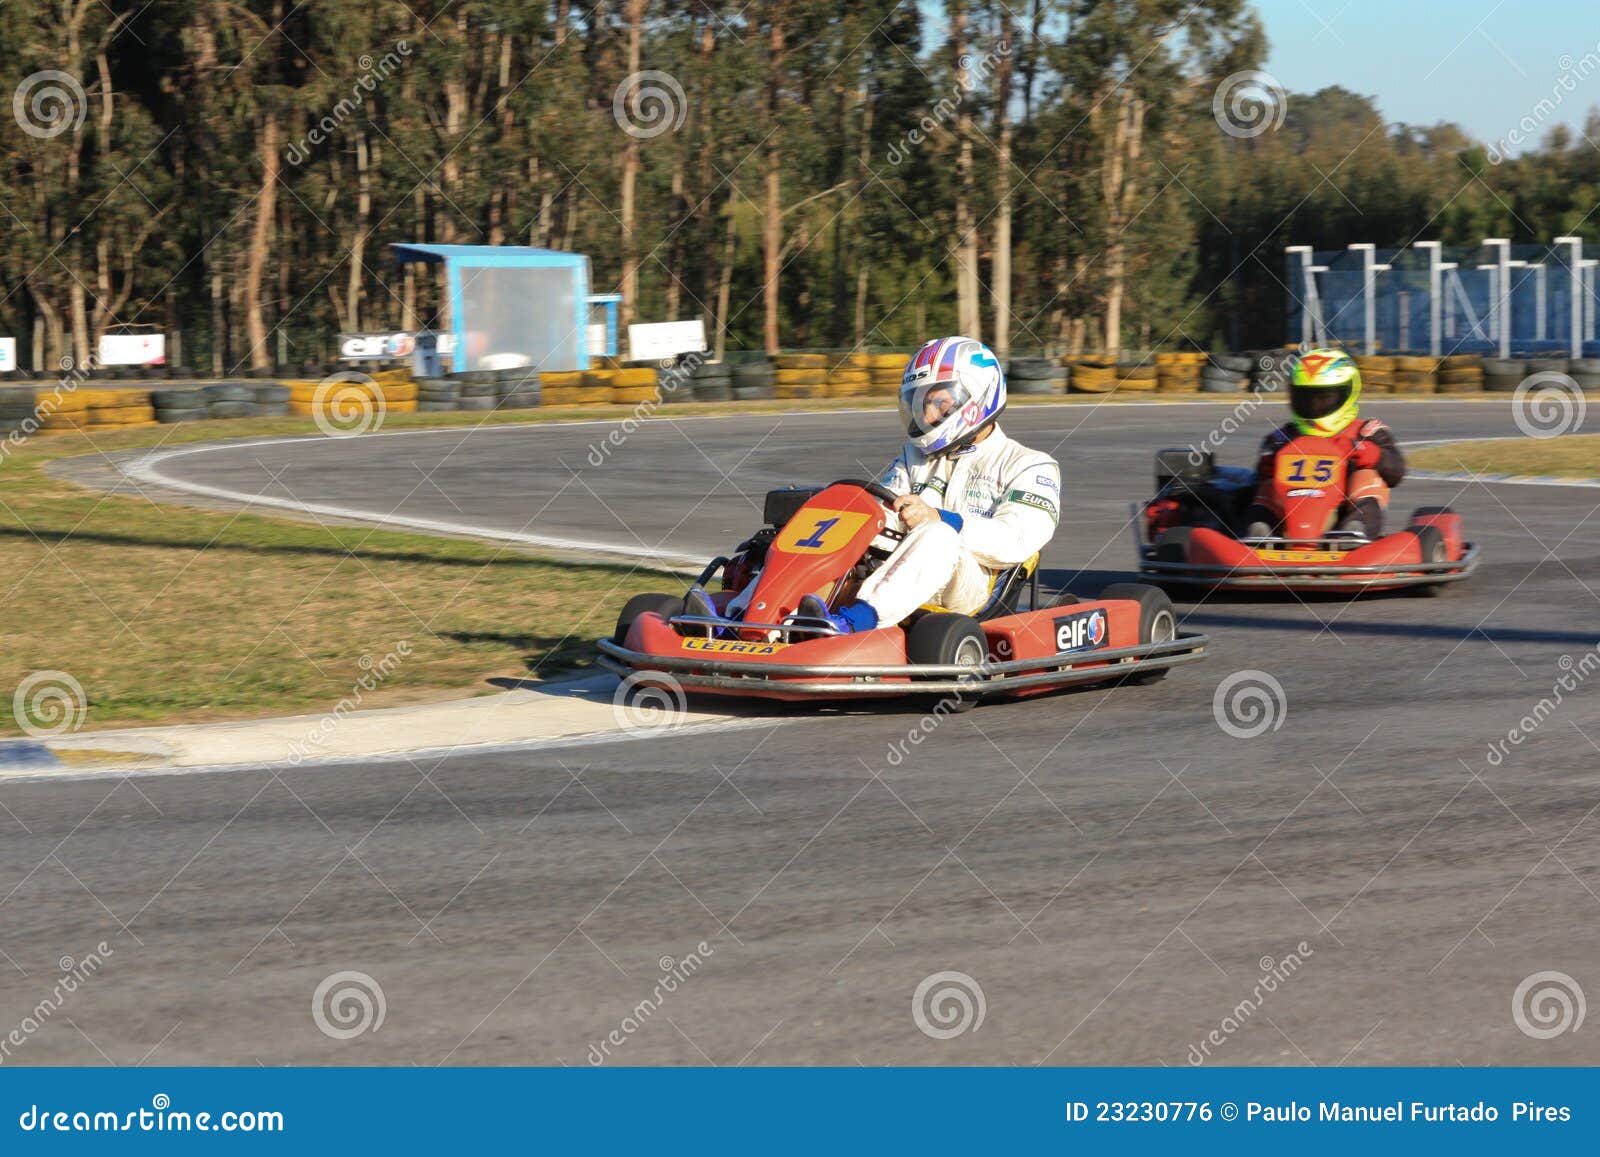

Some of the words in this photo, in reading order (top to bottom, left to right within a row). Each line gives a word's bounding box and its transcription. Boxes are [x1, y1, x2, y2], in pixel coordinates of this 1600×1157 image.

[1287, 459, 1334, 482] 15
[795, 517, 840, 549] 1
[686, 640, 775, 654] LEIRIA
[1057, 618, 1087, 650] elf
